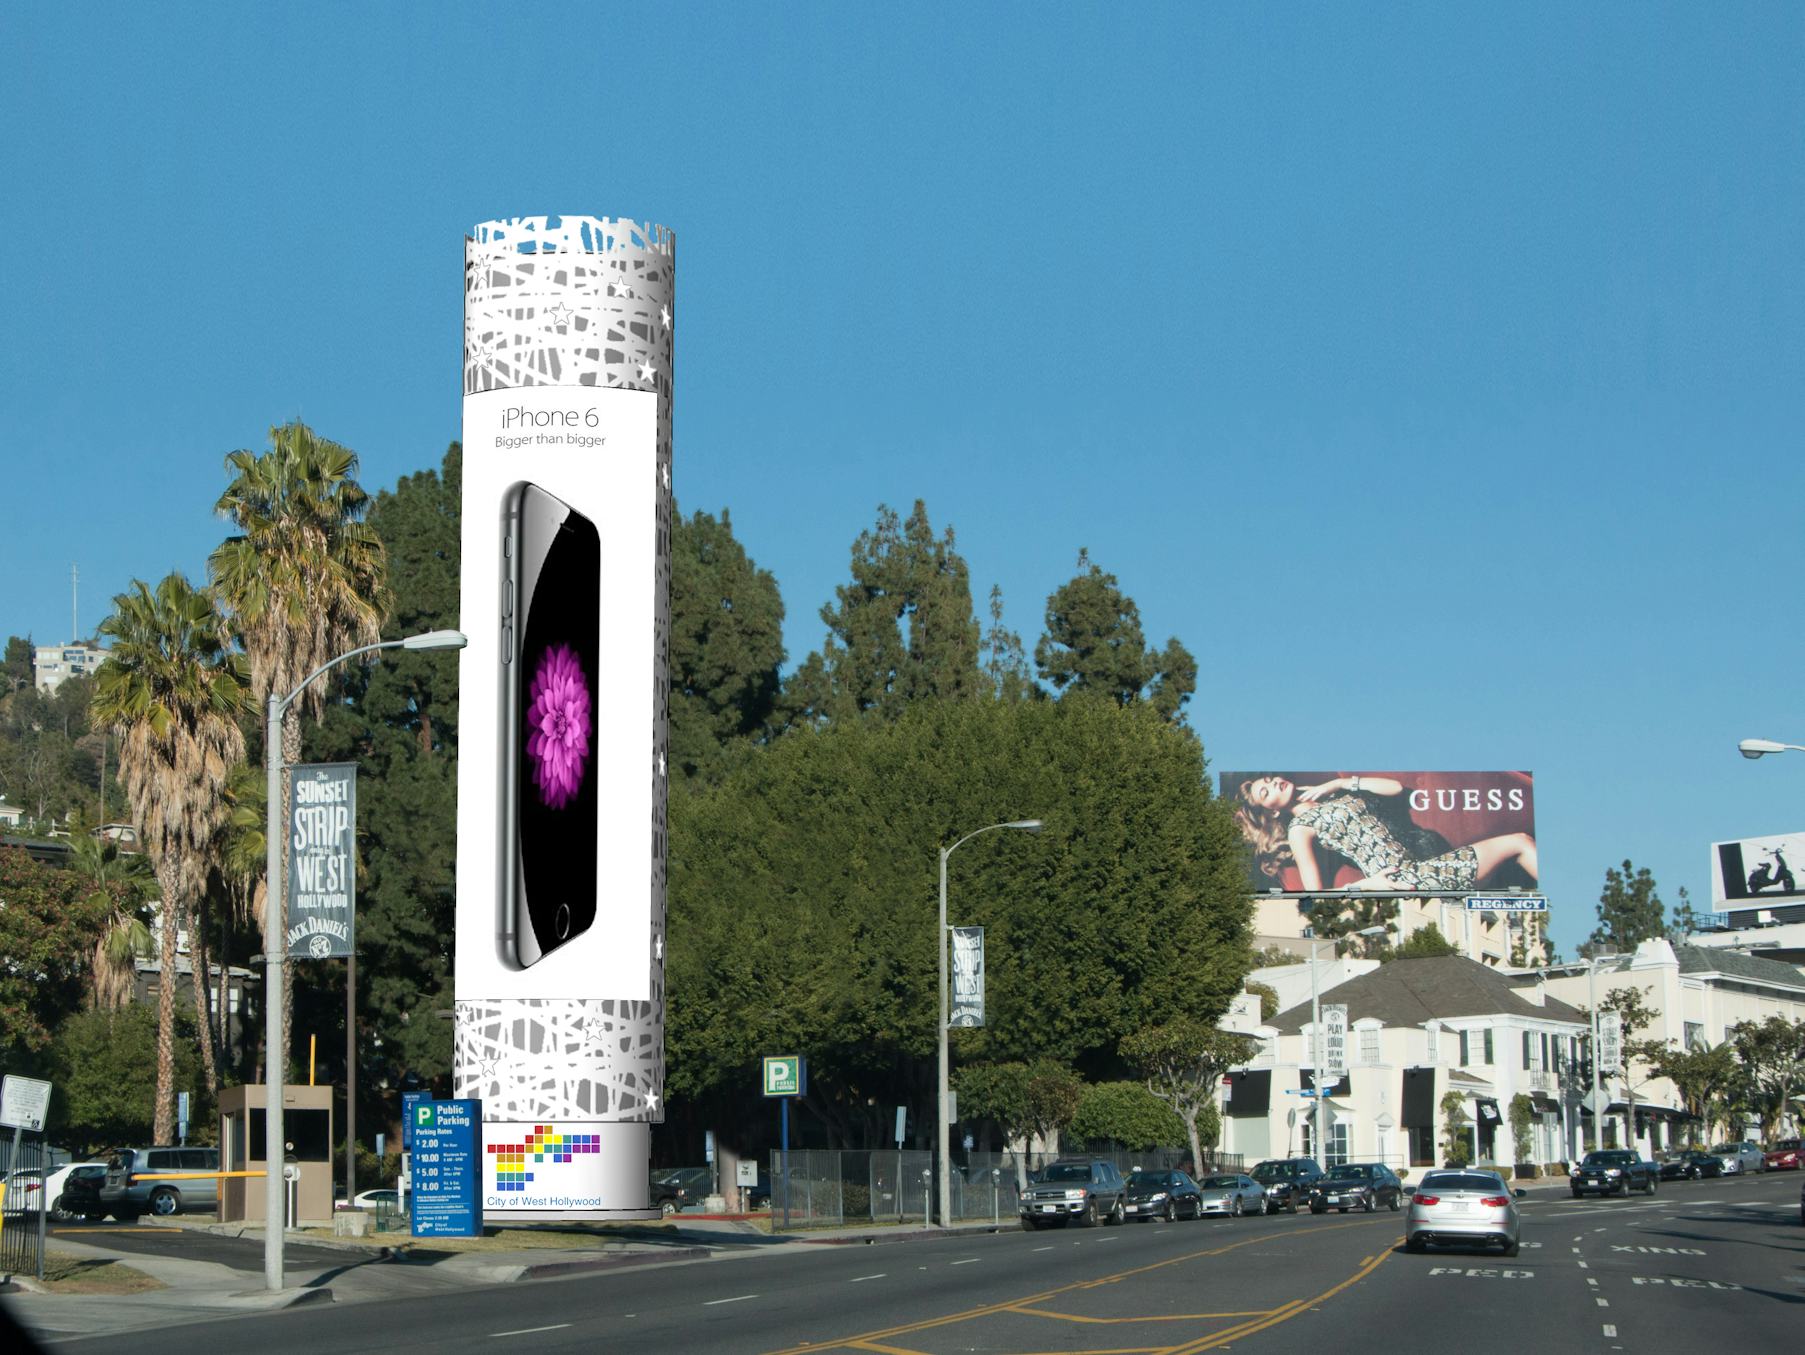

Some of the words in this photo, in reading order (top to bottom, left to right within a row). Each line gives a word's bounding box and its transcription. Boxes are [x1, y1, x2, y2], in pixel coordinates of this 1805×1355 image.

[502, 405, 580, 429] iPhone
[584, 407, 600, 428] 6
[495, 435, 534, 449] Bigger
[536, 432, 564, 445] than
[566, 432, 607, 448] bigger
[296, 779, 350, 804] SUNSET
[1409, 788, 1524, 811] GUESS
[294, 805, 349, 851] STRIP
[296, 853, 348, 893] WEST
[297, 893, 348, 909] HOLLYWOOD
[1470, 899, 1542, 910] REGENCY
[288, 921, 310, 948] JACK
[308, 916, 349, 942] DANIEL'S
[1327, 1023, 1343, 1035] PLAY
[1327, 1037, 1343, 1049] LOUD
[768, 1061, 789, 1092] P
[418, 1107, 431, 1125] P
[437, 1105, 464, 1115] Public
[437, 1115, 470, 1127] Parking
[422, 1139, 438, 1148] 2.00
[421, 1153, 439, 1162] 10.00
[421, 1168, 438, 1176] 5.00
[422, 1182, 438, 1191] 8.00
[487, 1196, 506, 1208] City
[509, 1196, 519, 1206] of
[521, 1197, 547, 1206] West
[550, 1196, 601, 1208] Hollywood
[1609, 1245, 1708, 1256] XING
[1428, 1267, 1535, 1279] PED
